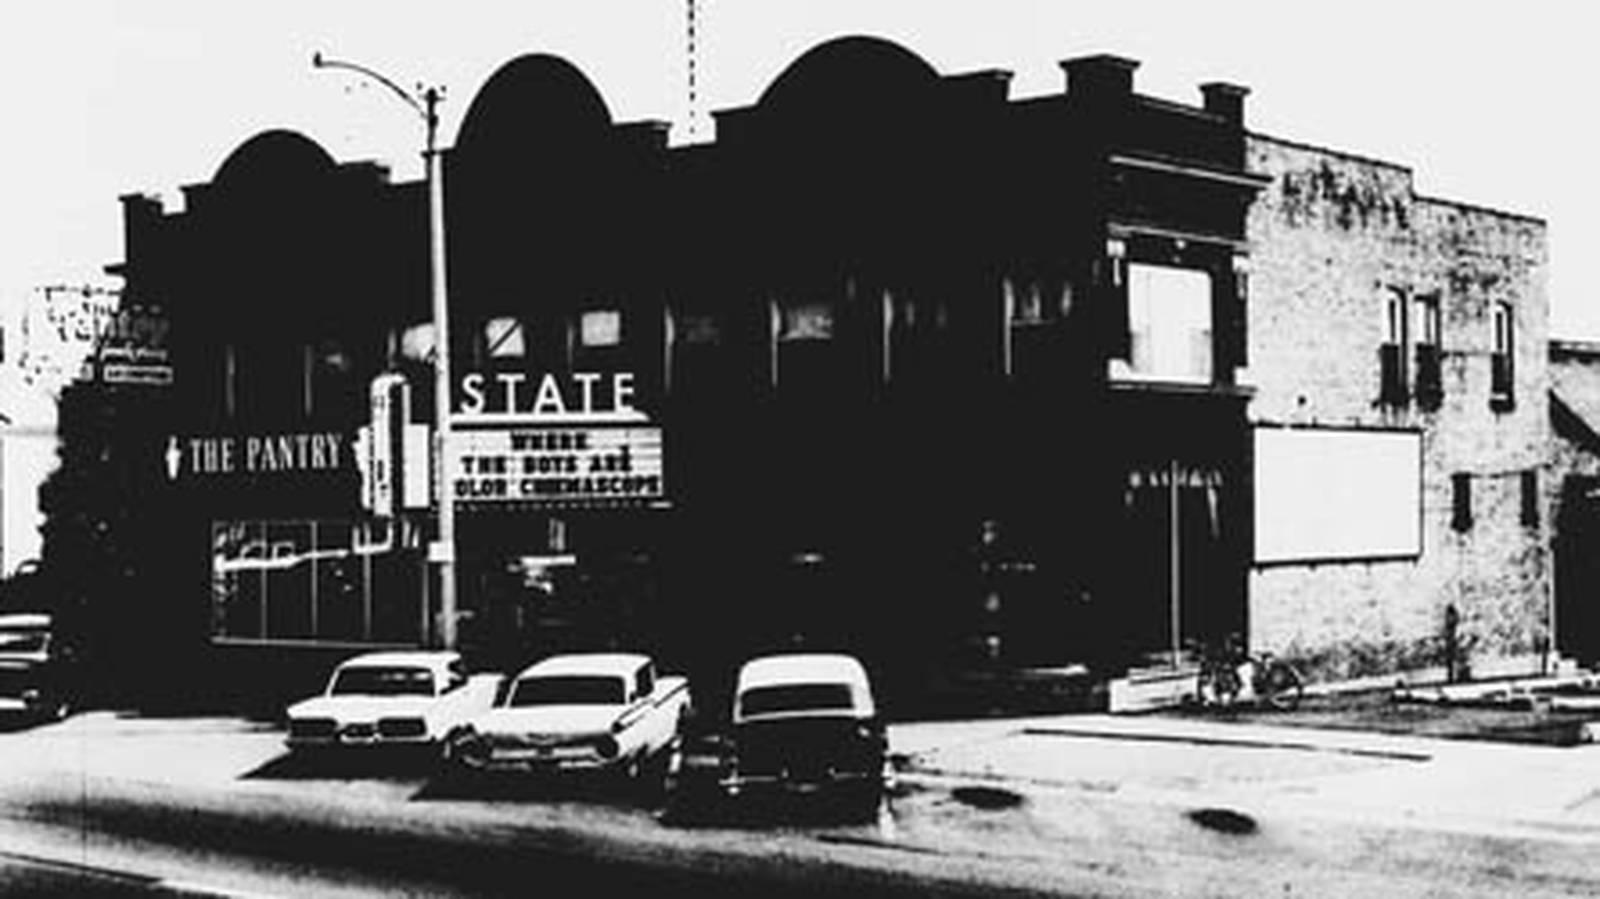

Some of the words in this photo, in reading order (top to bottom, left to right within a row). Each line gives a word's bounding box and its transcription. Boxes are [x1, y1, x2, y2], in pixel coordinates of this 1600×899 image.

[460, 372, 635, 414] STATE
[190, 437, 235, 474] THE
[246, 431, 342, 472] PANTRY
[509, 432, 588, 451] WHERE
[460, 455, 508, 475] THE
[522, 454, 578, 474] BOYS
[588, 445, 632, 473] ARE
[453, 478, 508, 498] OLOR
[519, 473, 661, 496] CMASCOPE
